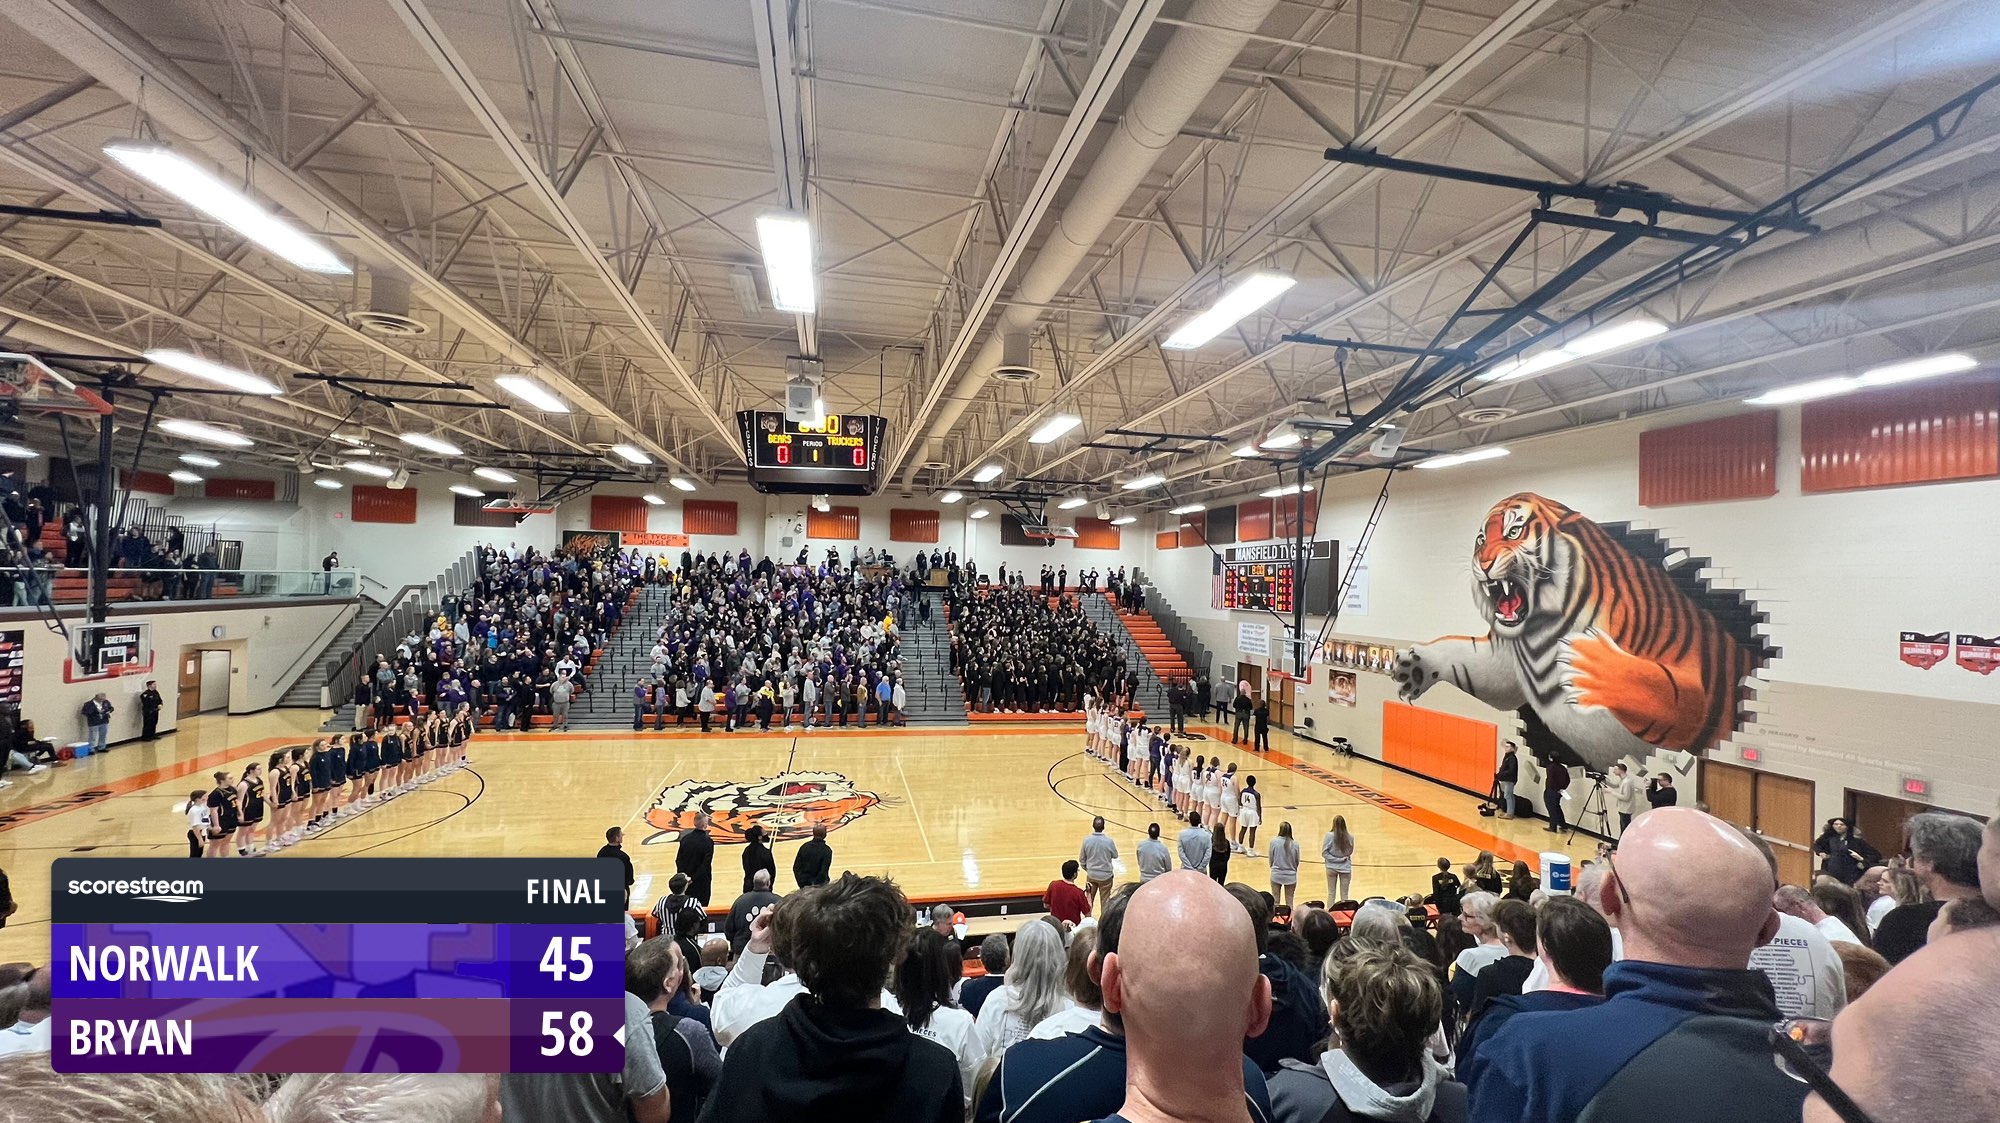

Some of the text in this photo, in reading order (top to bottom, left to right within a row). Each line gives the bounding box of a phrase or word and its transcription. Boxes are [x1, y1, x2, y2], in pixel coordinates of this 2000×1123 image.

[767, 434, 792, 444] BEARS
[827, 436, 864, 447] TRUCKERS
[1235, 546, 1278, 560] MANSFIELD
[1288, 764, 1412, 809] MANSFIELD
[1774, 938, 1809, 947] PIECES
